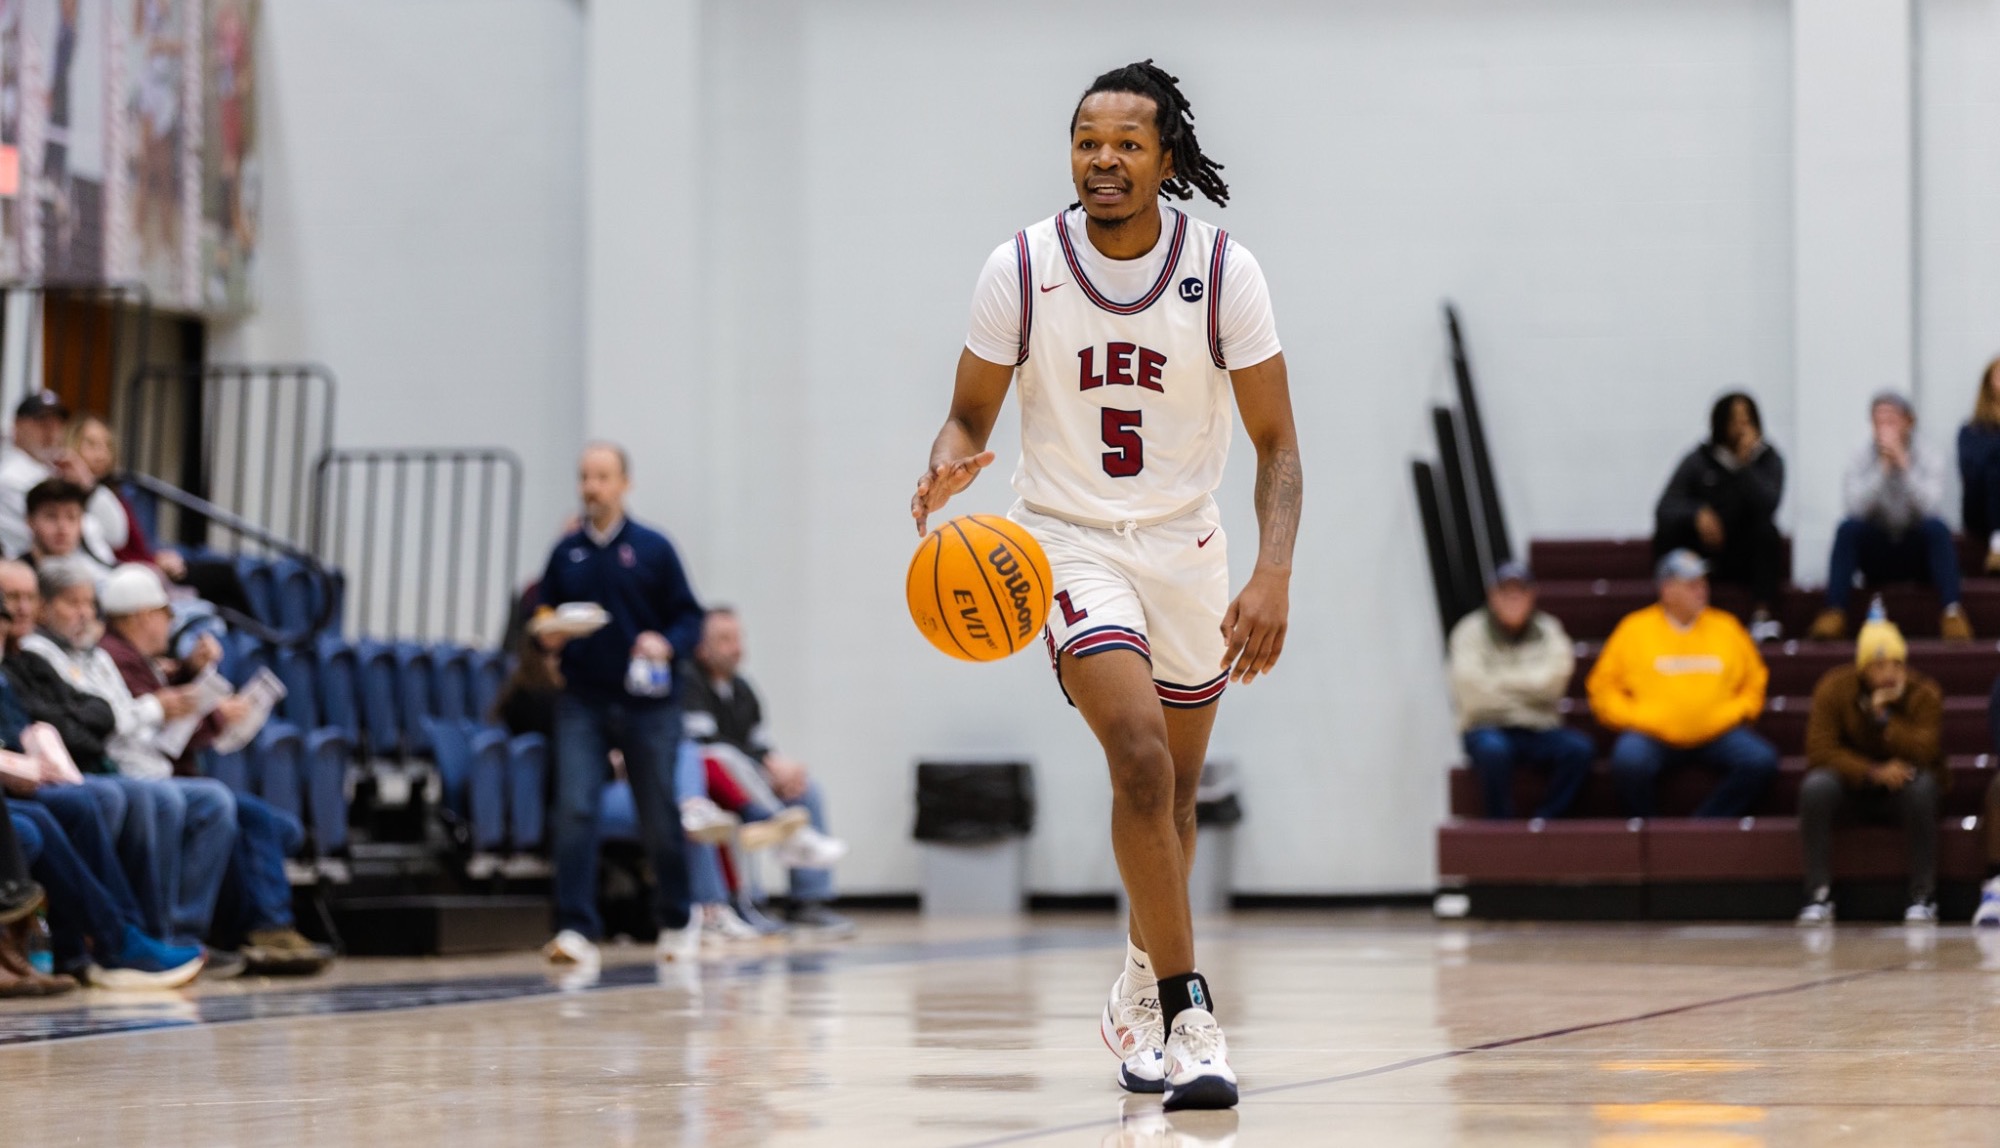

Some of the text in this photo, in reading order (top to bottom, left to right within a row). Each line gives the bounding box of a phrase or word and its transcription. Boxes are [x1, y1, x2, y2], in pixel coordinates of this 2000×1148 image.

[1181, 283, 1203, 298] LC
[1078, 342, 1167, 394] LEE
[1101, 406, 1144, 478] 5
[953, 589, 990, 639] EVO
[988, 542, 1032, 640] Wilson
[1054, 589, 1089, 628] L
